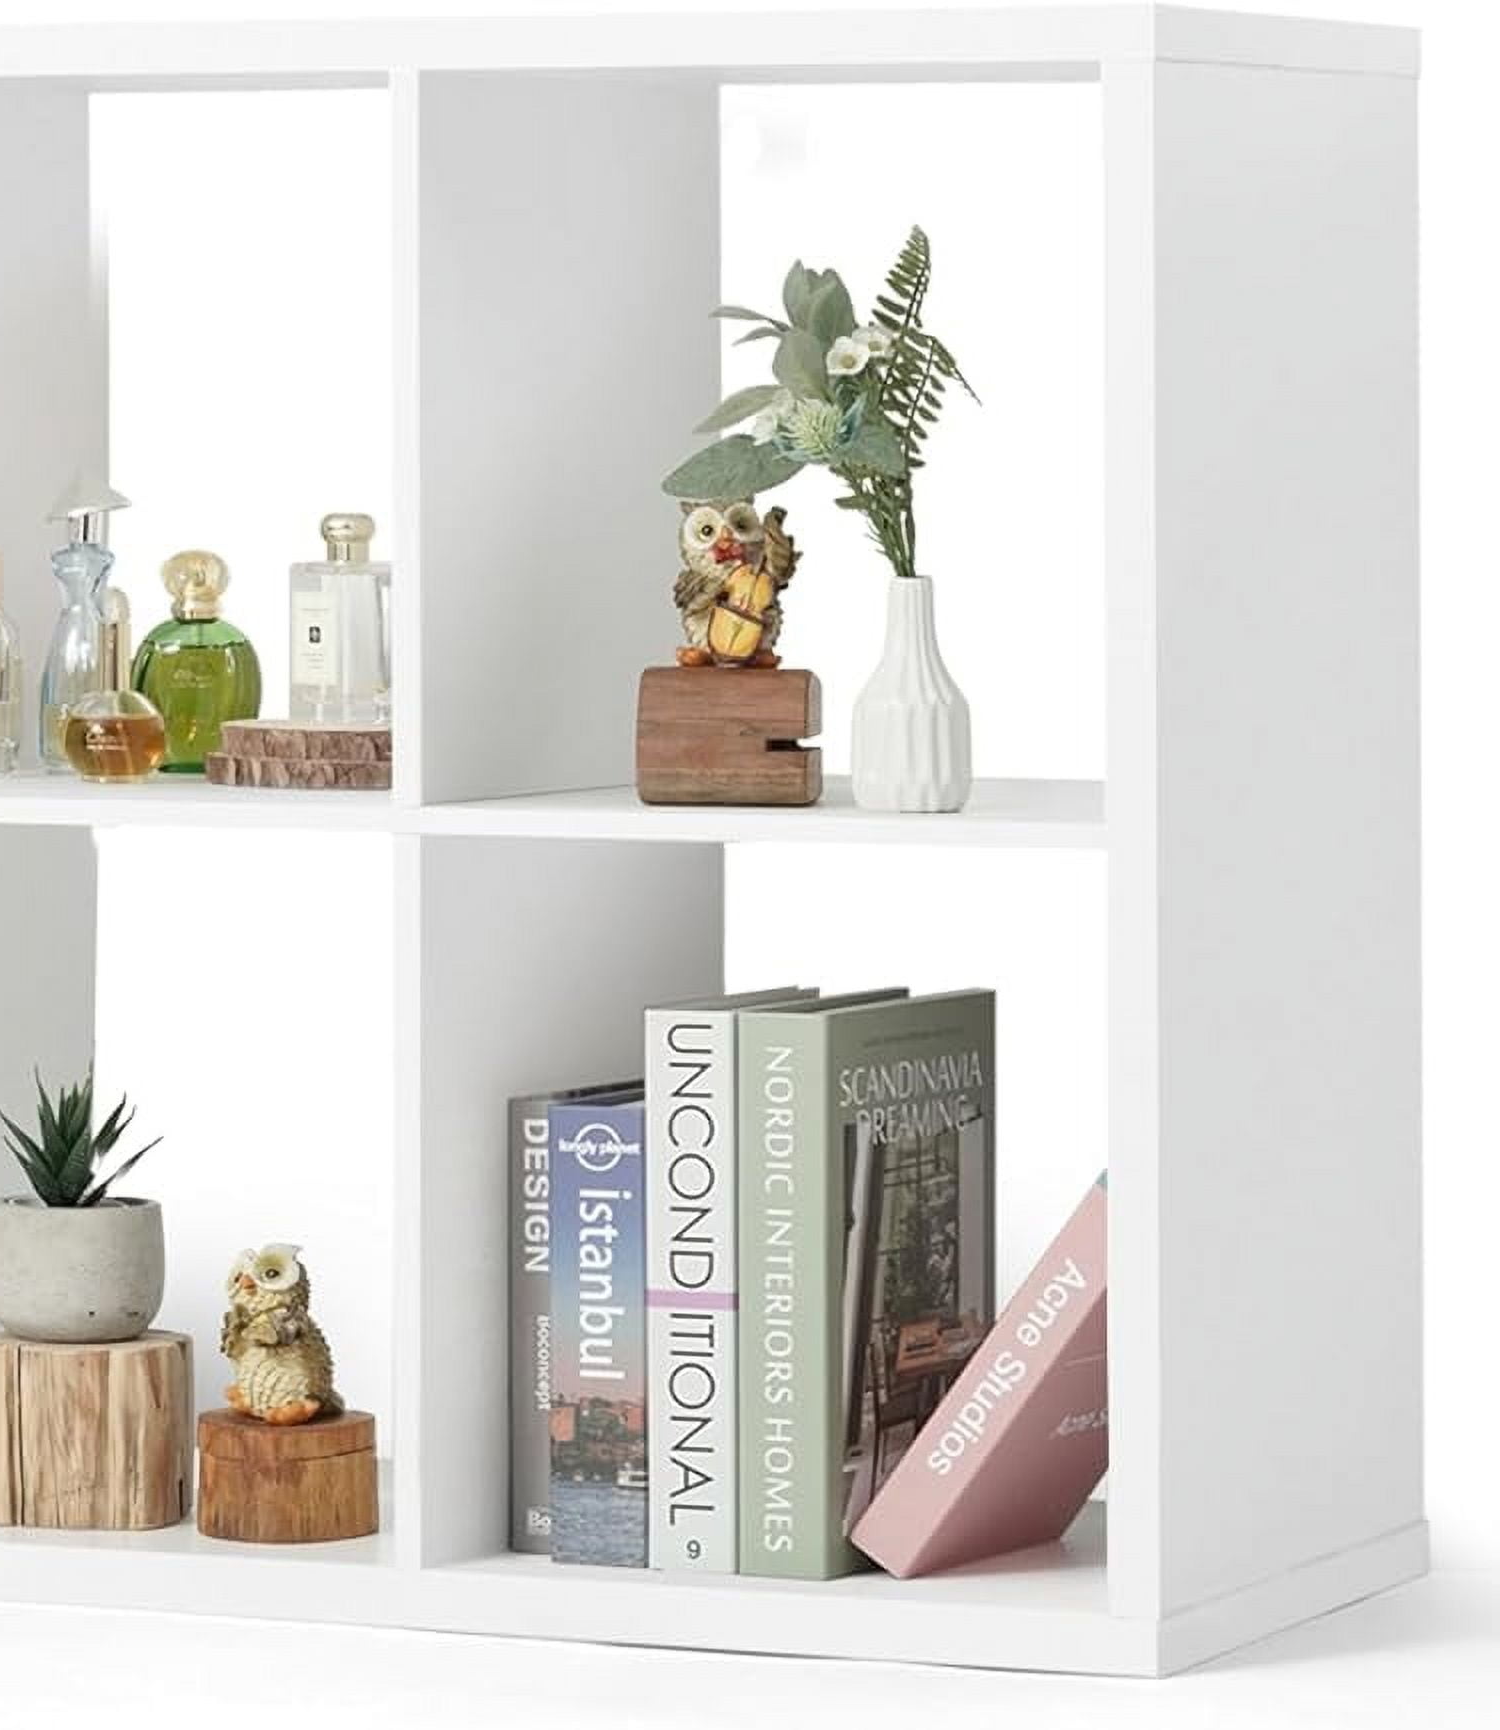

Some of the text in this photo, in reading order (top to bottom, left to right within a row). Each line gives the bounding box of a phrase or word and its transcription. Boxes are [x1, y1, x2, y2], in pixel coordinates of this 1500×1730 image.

[839, 1050, 984, 1107] SCANDINAVIA
[523, 1118, 550, 1273] DESIGN
[763, 1046, 794, 1553] NORDIC INTERIORS HOMES
[1016, 1257, 1088, 1347] Acne
[927, 1351, 1027, 1476] Studios
